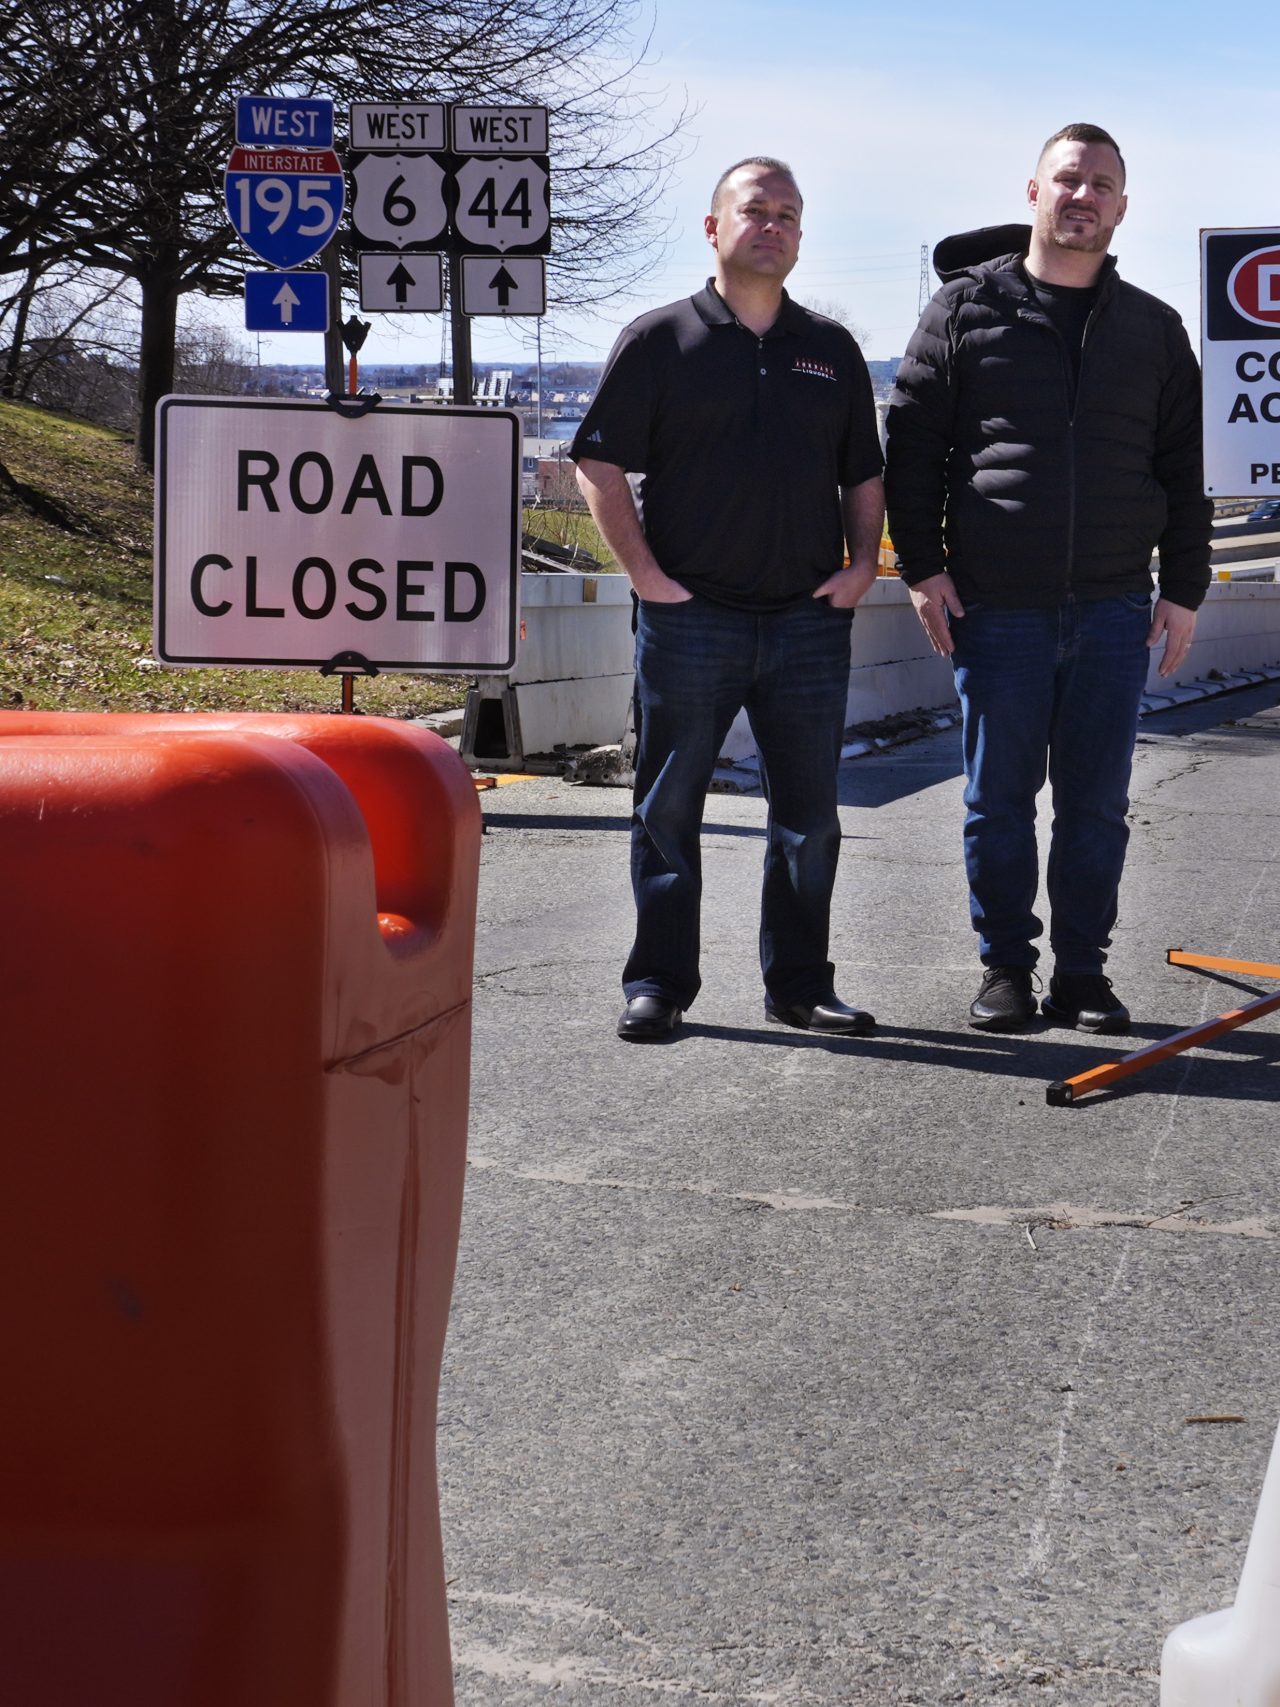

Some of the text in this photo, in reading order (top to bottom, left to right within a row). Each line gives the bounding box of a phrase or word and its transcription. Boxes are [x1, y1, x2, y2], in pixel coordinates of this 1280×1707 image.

[252, 106, 319, 138] WEST
[367, 113, 427, 140] WEST
[470, 116, 532, 144] WEST
[244, 154, 325, 172] INTERSTATE
[235, 179, 333, 237] 195
[382, 176, 416, 226] 6
[469, 178, 532, 229] 44
[237, 449, 445, 517] ROAD
[191, 554, 487, 623] CLOSED
